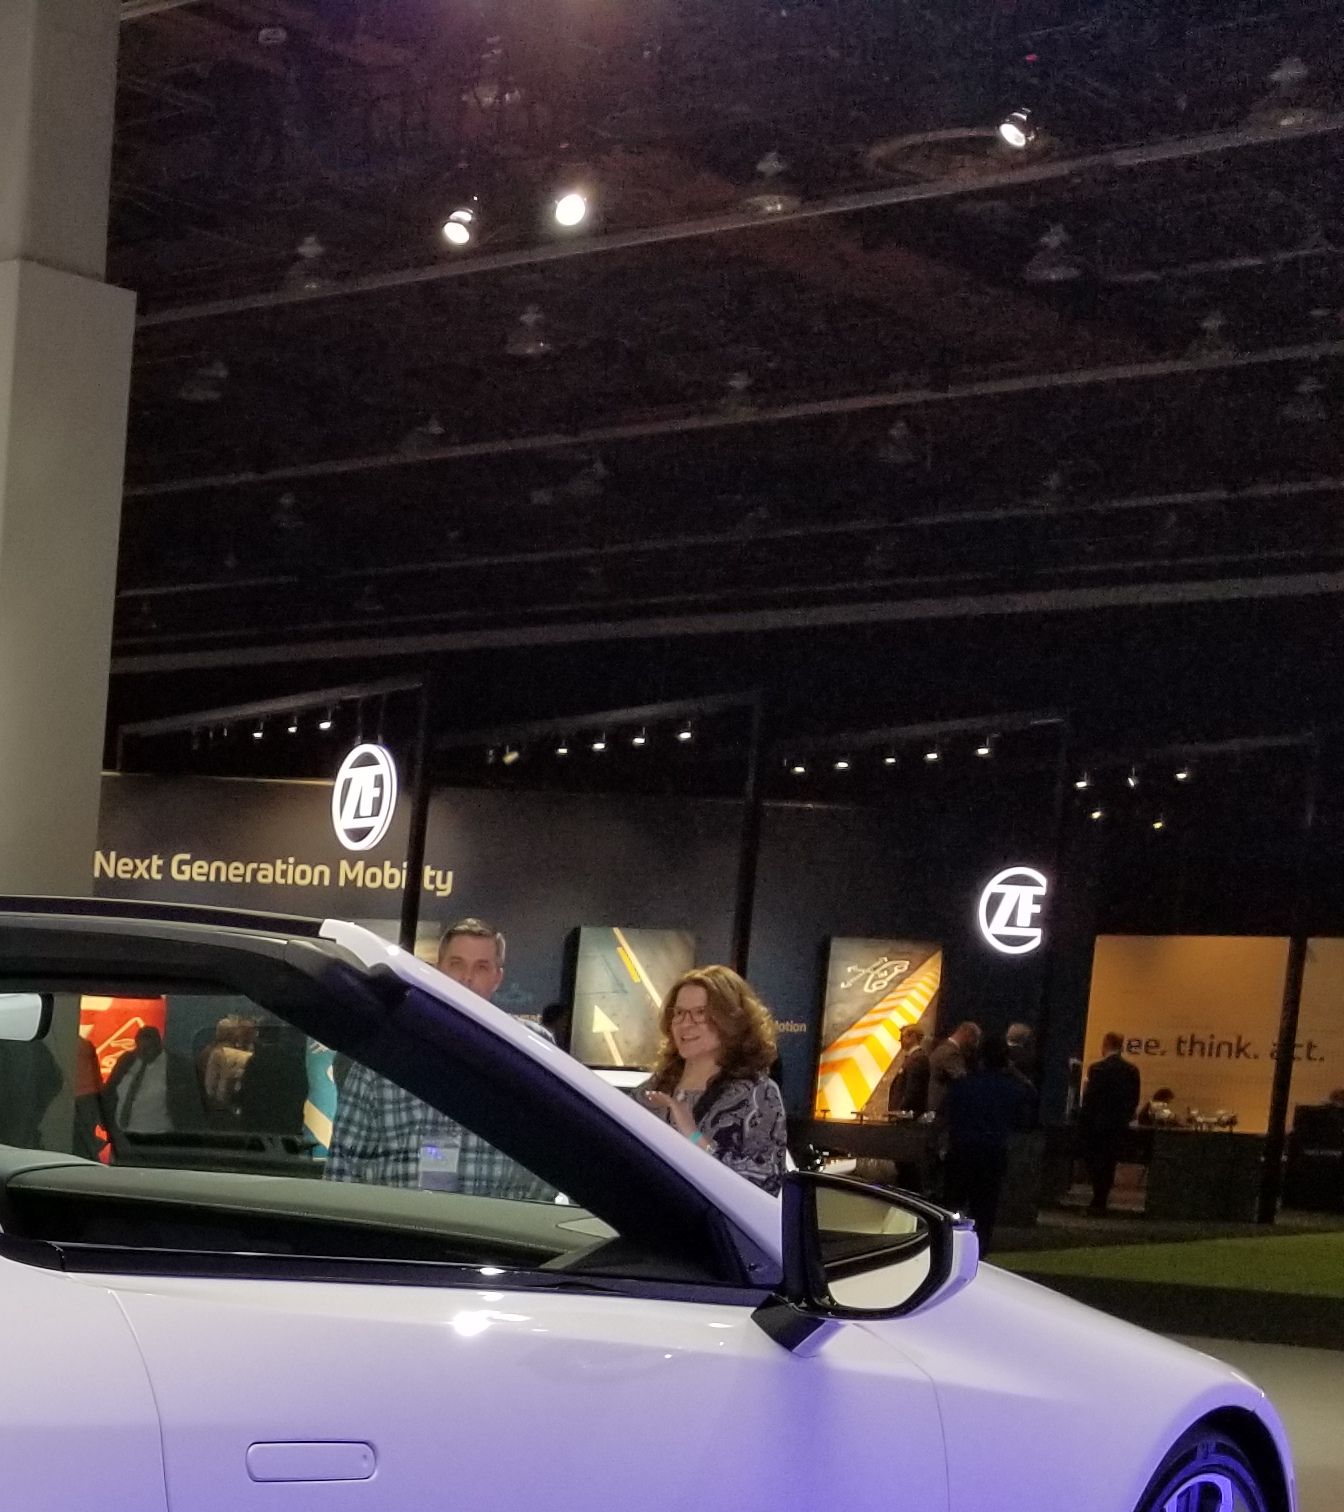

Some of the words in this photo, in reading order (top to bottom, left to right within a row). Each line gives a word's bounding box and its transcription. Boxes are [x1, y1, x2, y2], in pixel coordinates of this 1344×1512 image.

[334, 761, 387, 832] ZF
[93, 850, 163, 882] Next
[170, 853, 330, 888] Generation
[338, 858, 454, 898] Mobity
[985, 880, 1047, 939] ZF
[1125, 1036, 1167, 1056] ee.
[1176, 1033, 1260, 1060] think.
